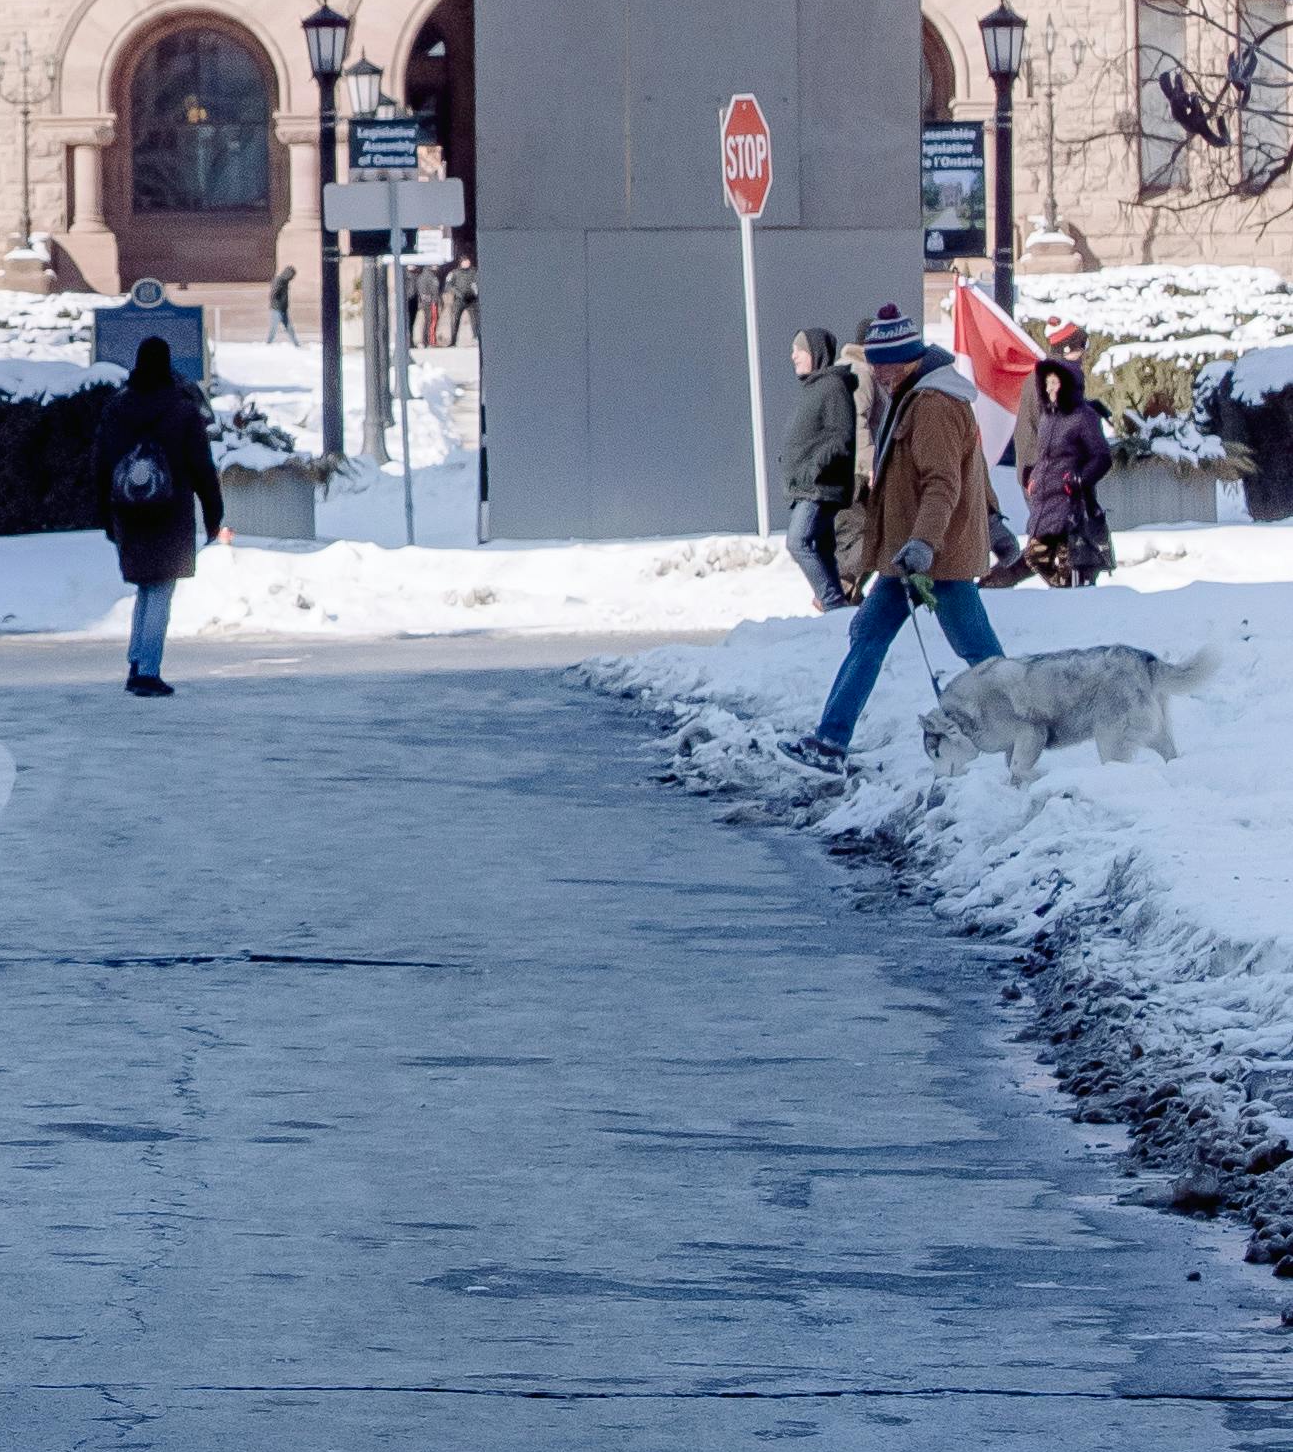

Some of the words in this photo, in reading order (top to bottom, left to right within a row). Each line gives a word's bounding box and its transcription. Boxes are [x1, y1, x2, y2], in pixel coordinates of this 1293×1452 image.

[357, 126, 416, 141] Legislative
[922, 128, 976, 141] ssemblée
[363, 140, 416, 154] Assembly
[358, 154, 371, 166] of
[373, 154, 416, 166] Ontario
[726, 134, 767, 180] STOP
